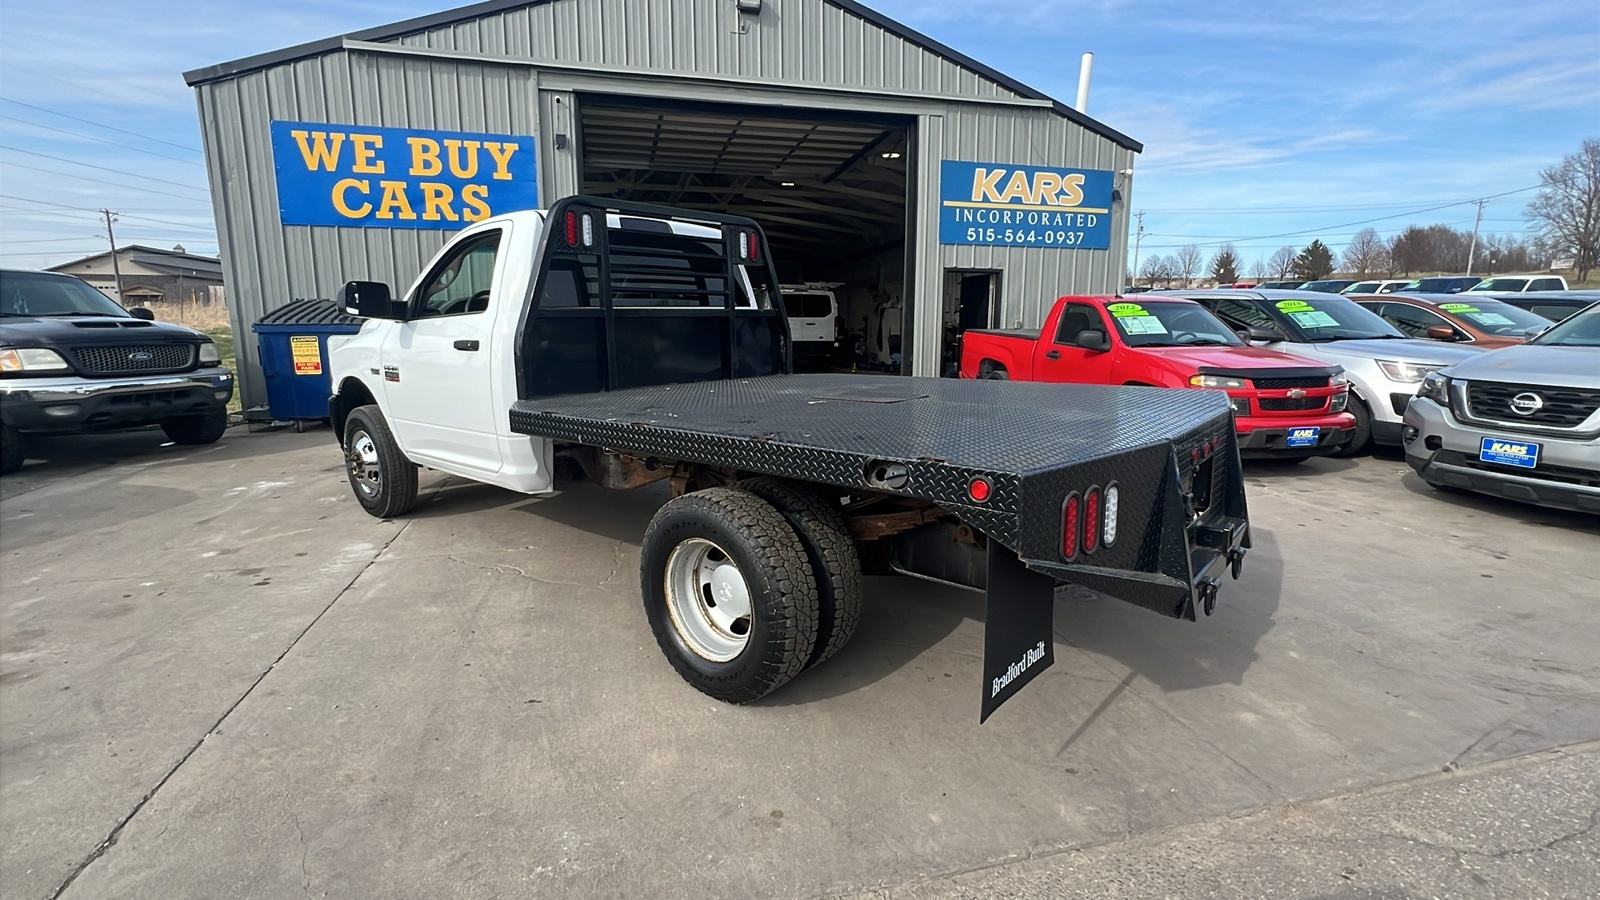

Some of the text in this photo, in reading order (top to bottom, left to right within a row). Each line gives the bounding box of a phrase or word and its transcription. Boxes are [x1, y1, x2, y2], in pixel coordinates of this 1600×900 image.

[291, 130, 519, 180] WE BUY
[332, 178, 492, 223] CARS
[971, 168, 1085, 206] KARS
[955, 208, 1098, 228] INCORPORATED
[966, 228, 1085, 245] 515-564-0937
[1491, 442, 1528, 455] KARS
[991, 641, 1045, 698] Bradford Built
